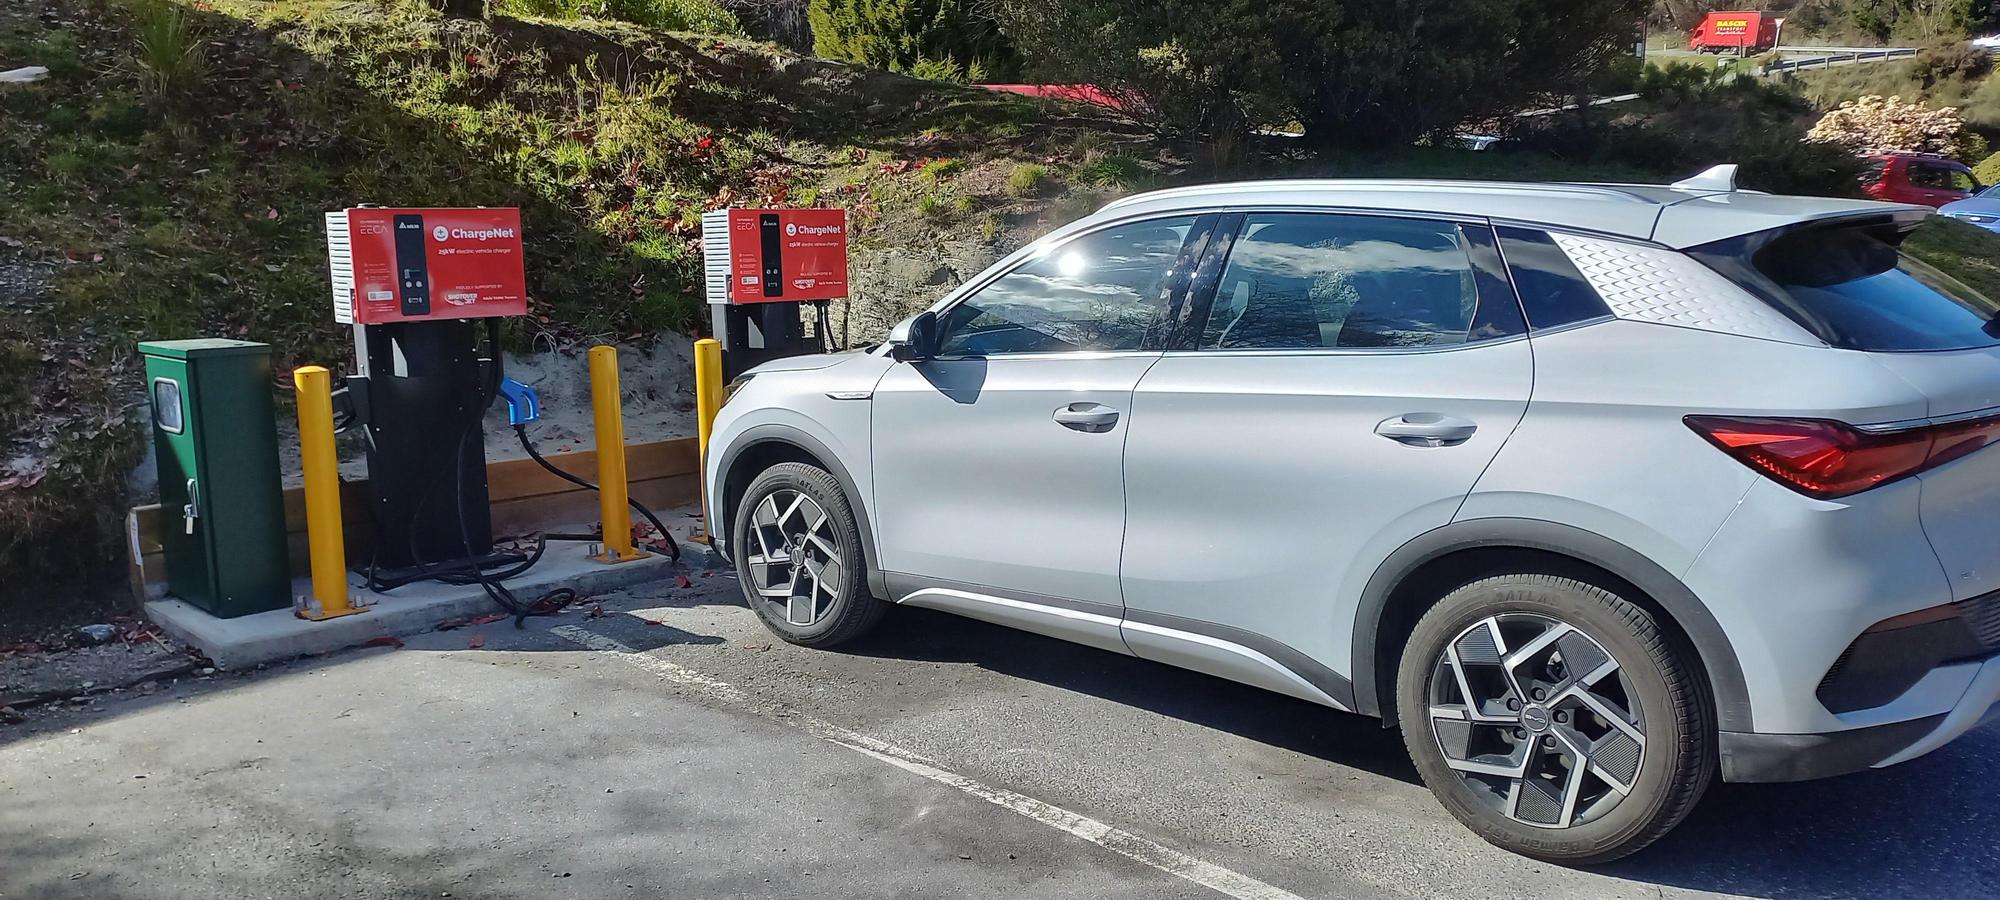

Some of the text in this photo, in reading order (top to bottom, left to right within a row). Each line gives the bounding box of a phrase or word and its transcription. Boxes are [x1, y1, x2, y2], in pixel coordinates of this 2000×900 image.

[360, 225, 388, 235] EECA
[451, 228, 515, 241] ChargeNet
[798, 225, 842, 236] ChargeNet
[438, 248, 456, 256] 25kW
[799, 480, 825, 501] ATLAS
